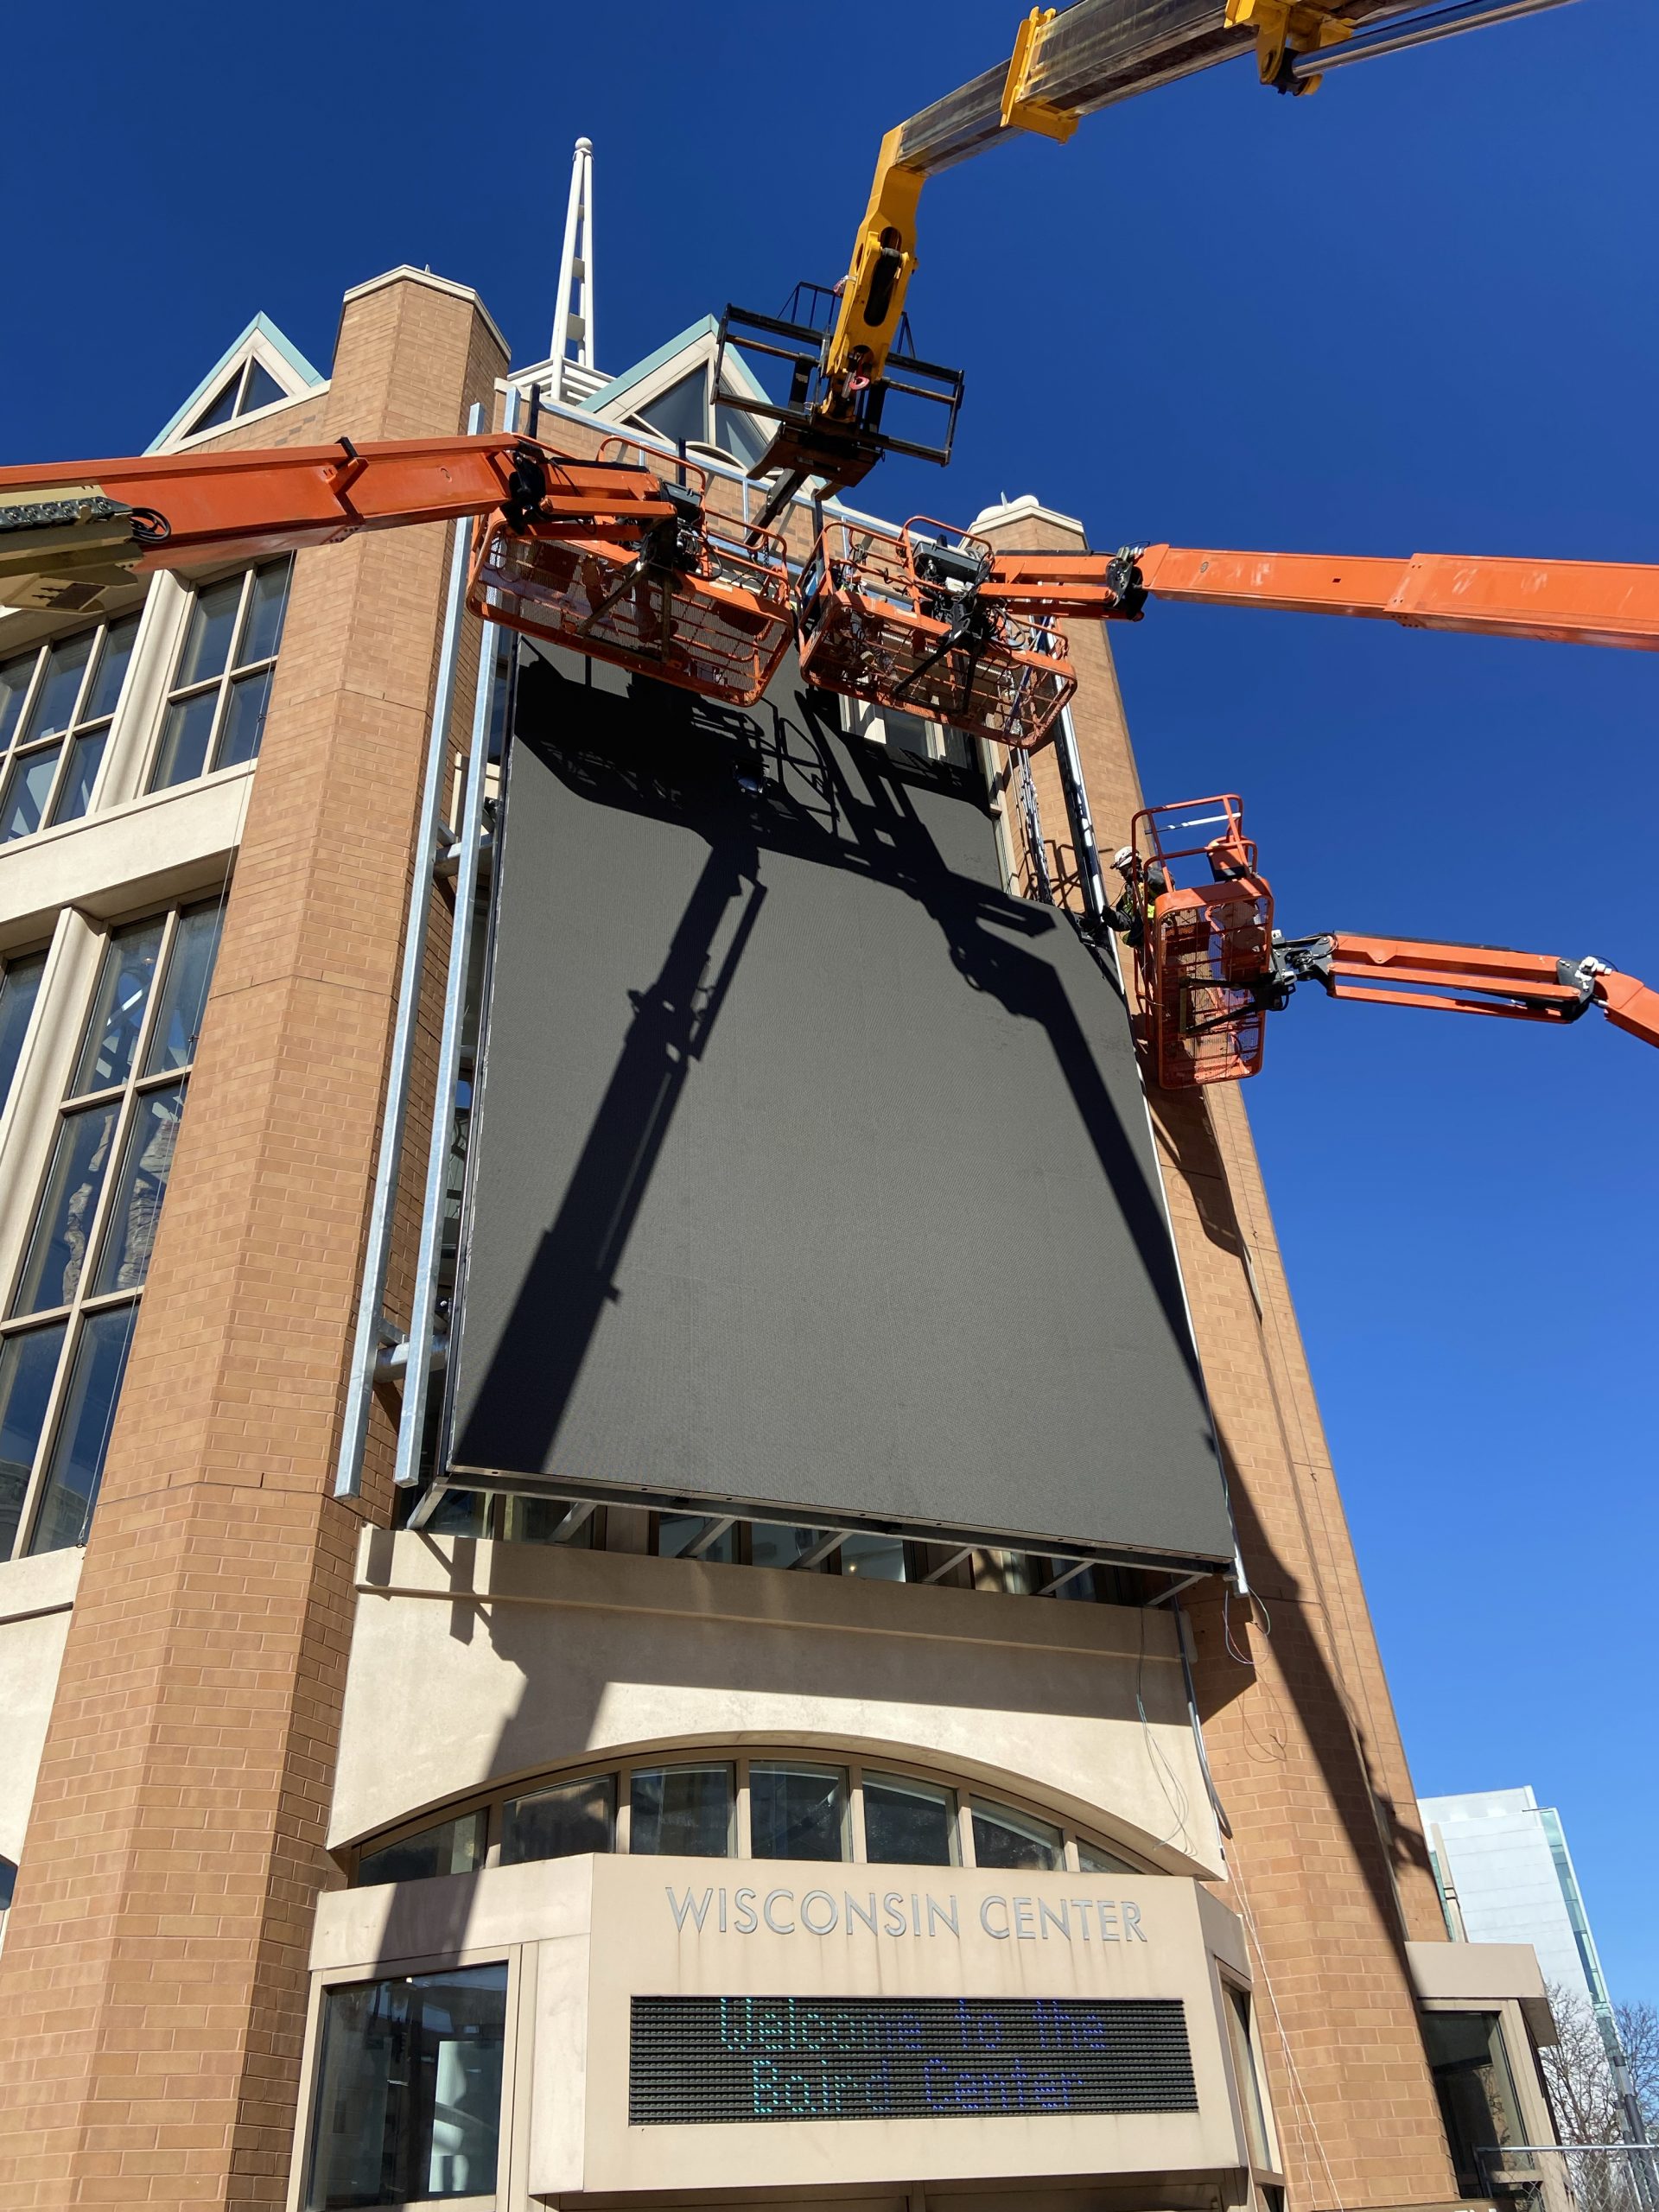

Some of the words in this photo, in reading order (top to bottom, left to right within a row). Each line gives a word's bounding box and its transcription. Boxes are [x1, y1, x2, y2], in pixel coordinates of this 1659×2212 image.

[665, 1886, 960, 1939] WISCONSIN
[980, 1895, 1148, 1943] CENTER
[719, 1997, 922, 2050] Welcome
[953, 1999, 1002, 2050] to
[1032, 1999, 1106, 2050] the
[752, 2058, 891, 2113] Baird
[923, 2058, 1084, 2111] Center
